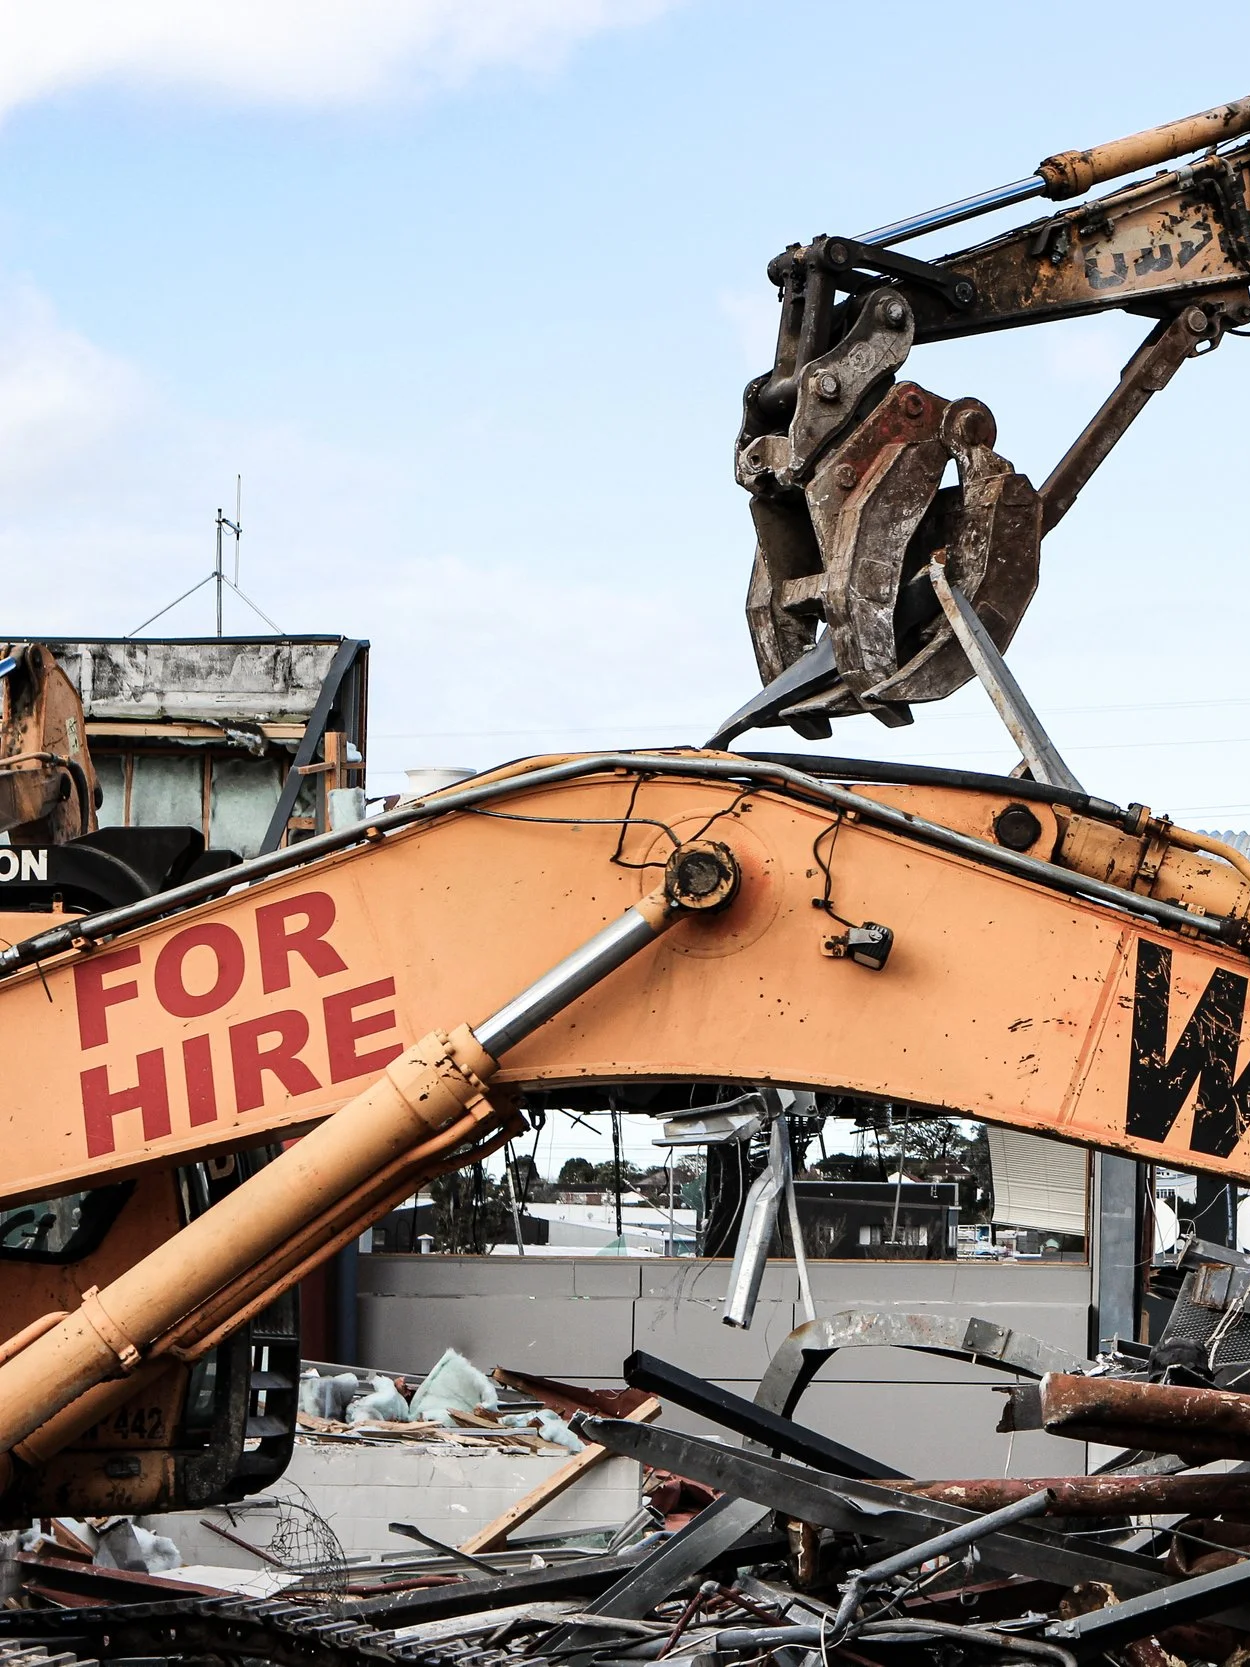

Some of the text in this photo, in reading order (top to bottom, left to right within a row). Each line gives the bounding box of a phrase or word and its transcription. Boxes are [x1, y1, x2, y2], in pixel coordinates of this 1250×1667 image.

[0, 848, 48, 882] ON
[73, 891, 349, 1051] FOR
[80, 976, 404, 1158] HIRE
[114, 1406, 164, 1439] 442
